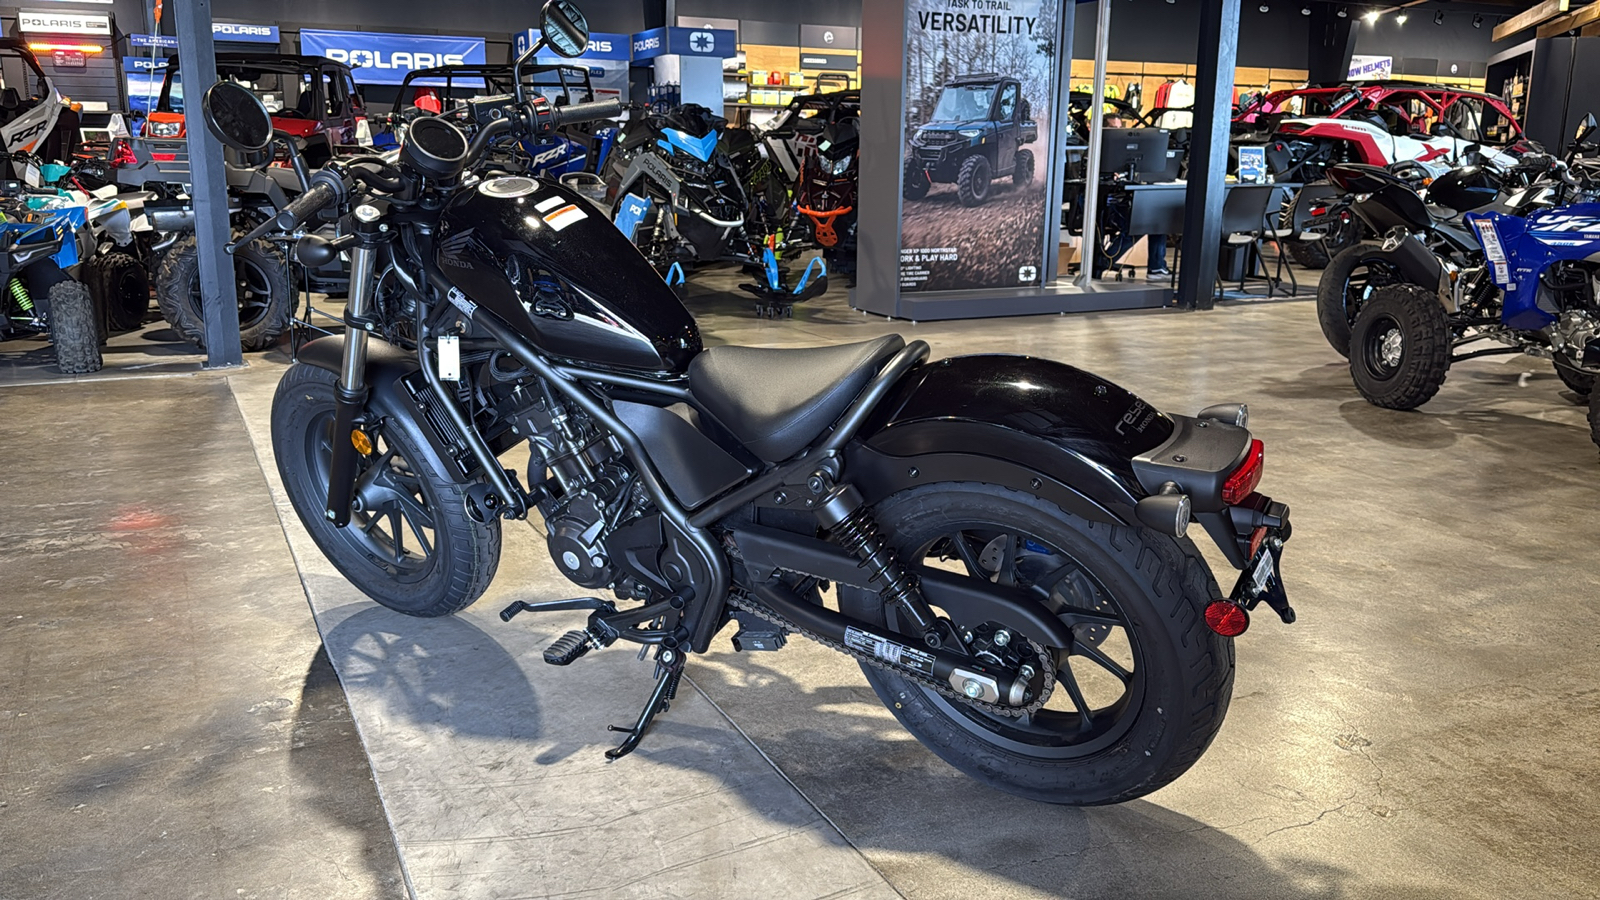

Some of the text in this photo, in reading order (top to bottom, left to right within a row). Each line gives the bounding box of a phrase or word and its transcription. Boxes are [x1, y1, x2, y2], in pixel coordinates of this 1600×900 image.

[947, 0, 1011, 11] TASK TO TRAIL
[22, 18, 82, 28] POLARIS
[212, 25, 271, 36] POLARIS
[918, 11, 1037, 35] VERSATILITY
[633, 36, 661, 53] POLARIS
[325, 48, 464, 71] POLARIS
[1363, 58, 1391, 74] HELMETS
[8, 120, 48, 148] RZR
[531, 143, 567, 169] RZR
[642, 158, 674, 188] POLARIS
[440, 256, 475, 270] HONDA
